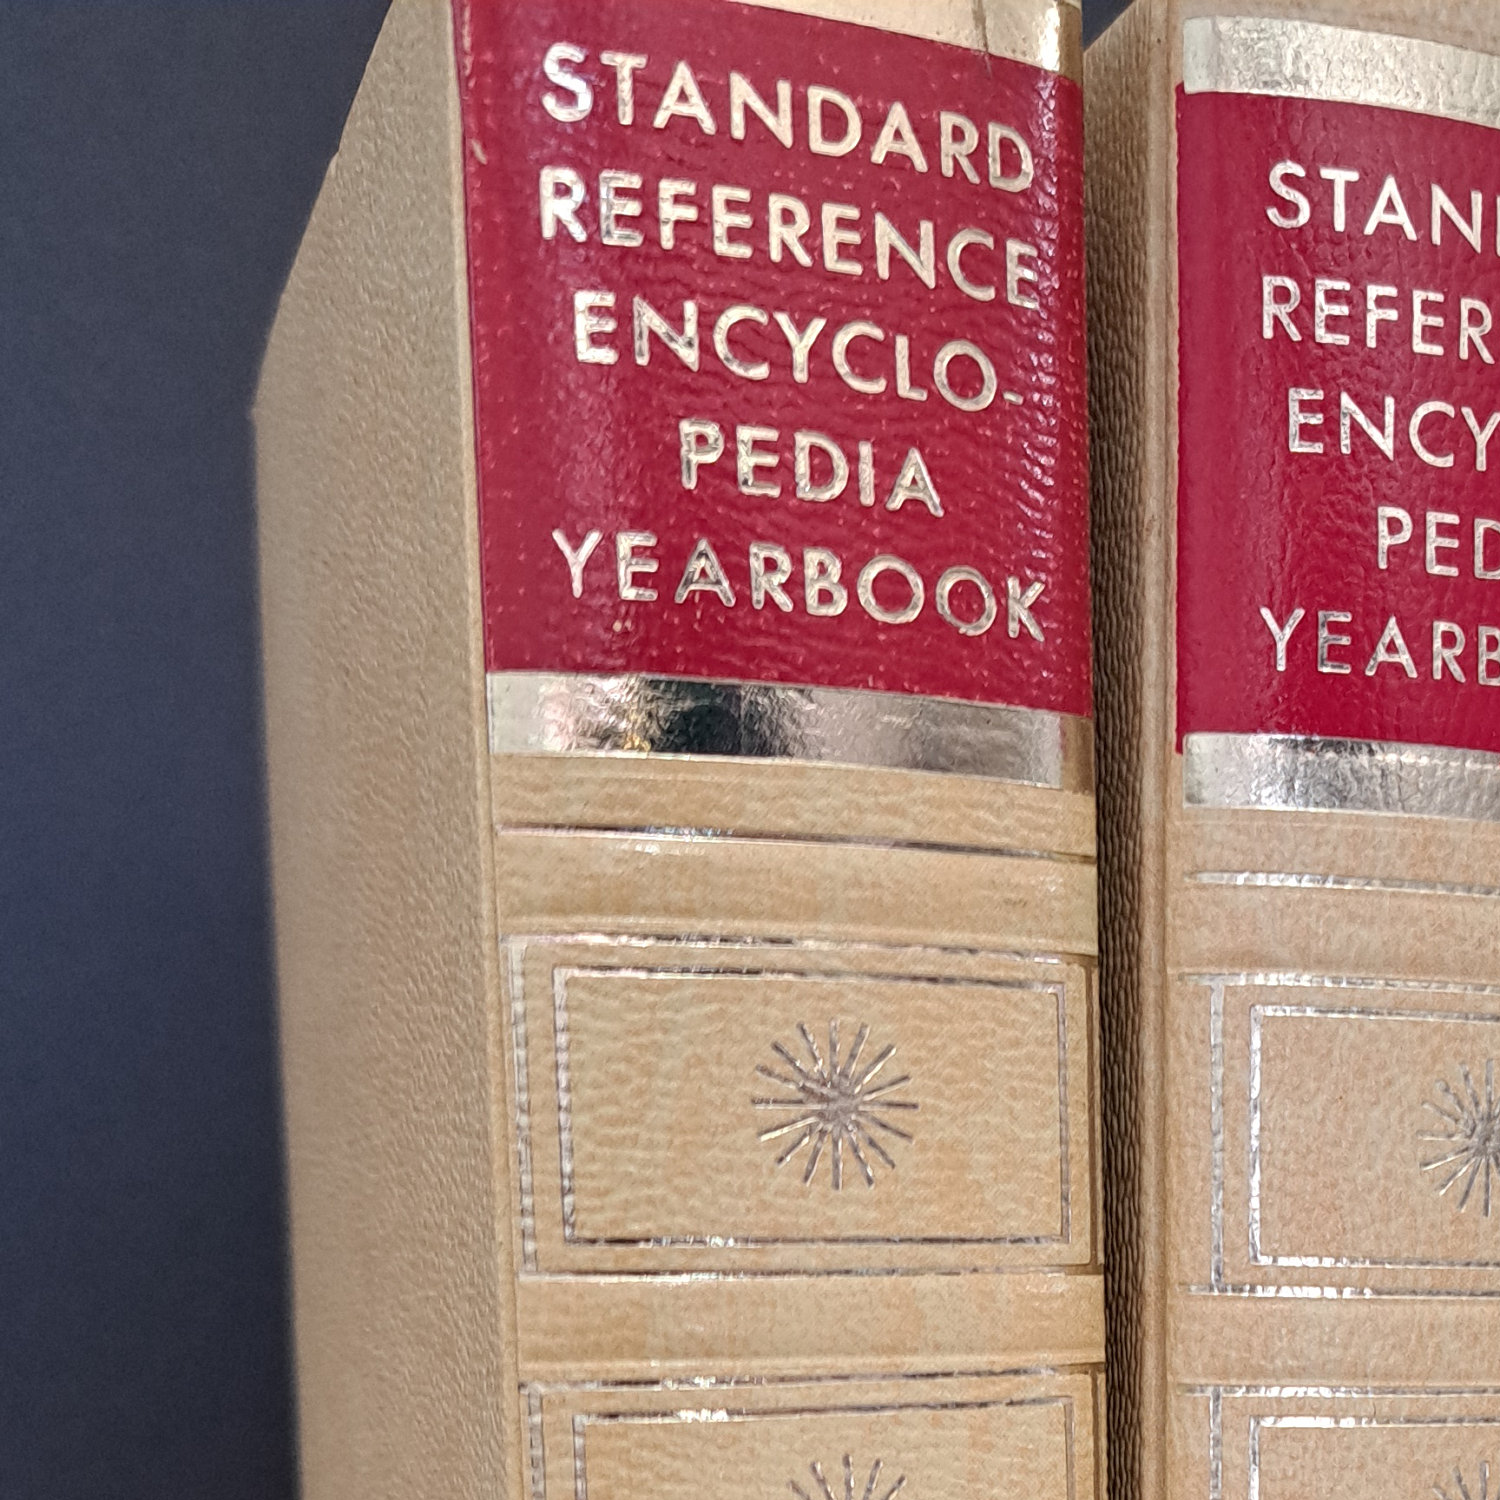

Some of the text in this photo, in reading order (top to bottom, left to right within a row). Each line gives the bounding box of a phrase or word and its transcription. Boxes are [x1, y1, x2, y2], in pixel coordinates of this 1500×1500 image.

[542, 41, 1034, 193] STANDARD
[539, 166, 1040, 309] REFERENCE
[679, 418, 944, 517] PEDIA
[552, 529, 1046, 642] YEARBOOK
